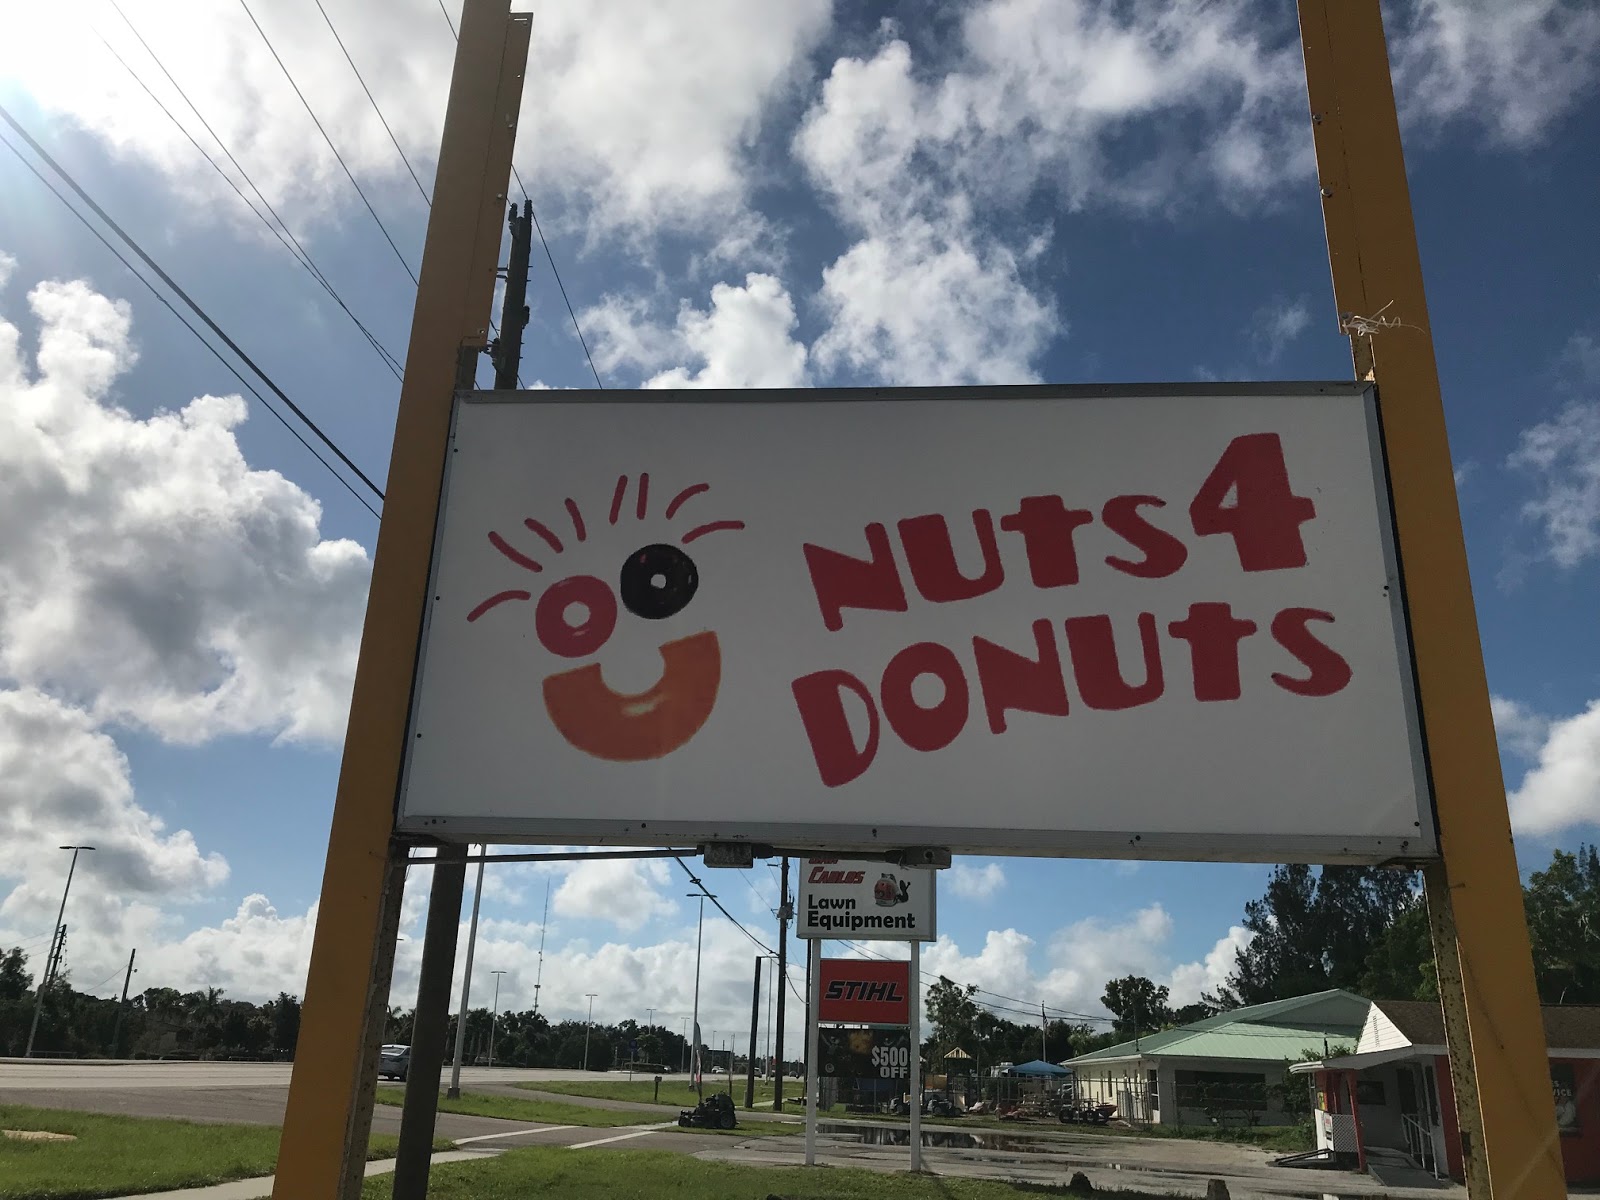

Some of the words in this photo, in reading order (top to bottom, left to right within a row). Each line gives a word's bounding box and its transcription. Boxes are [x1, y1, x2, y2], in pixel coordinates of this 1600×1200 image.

[808, 894, 856, 909] Lawn
[807, 911, 915, 931] Equipment
[824, 980, 904, 1002] STIHL
[872, 1045, 908, 1067] $500
[880, 1066, 908, 1079] OFF
